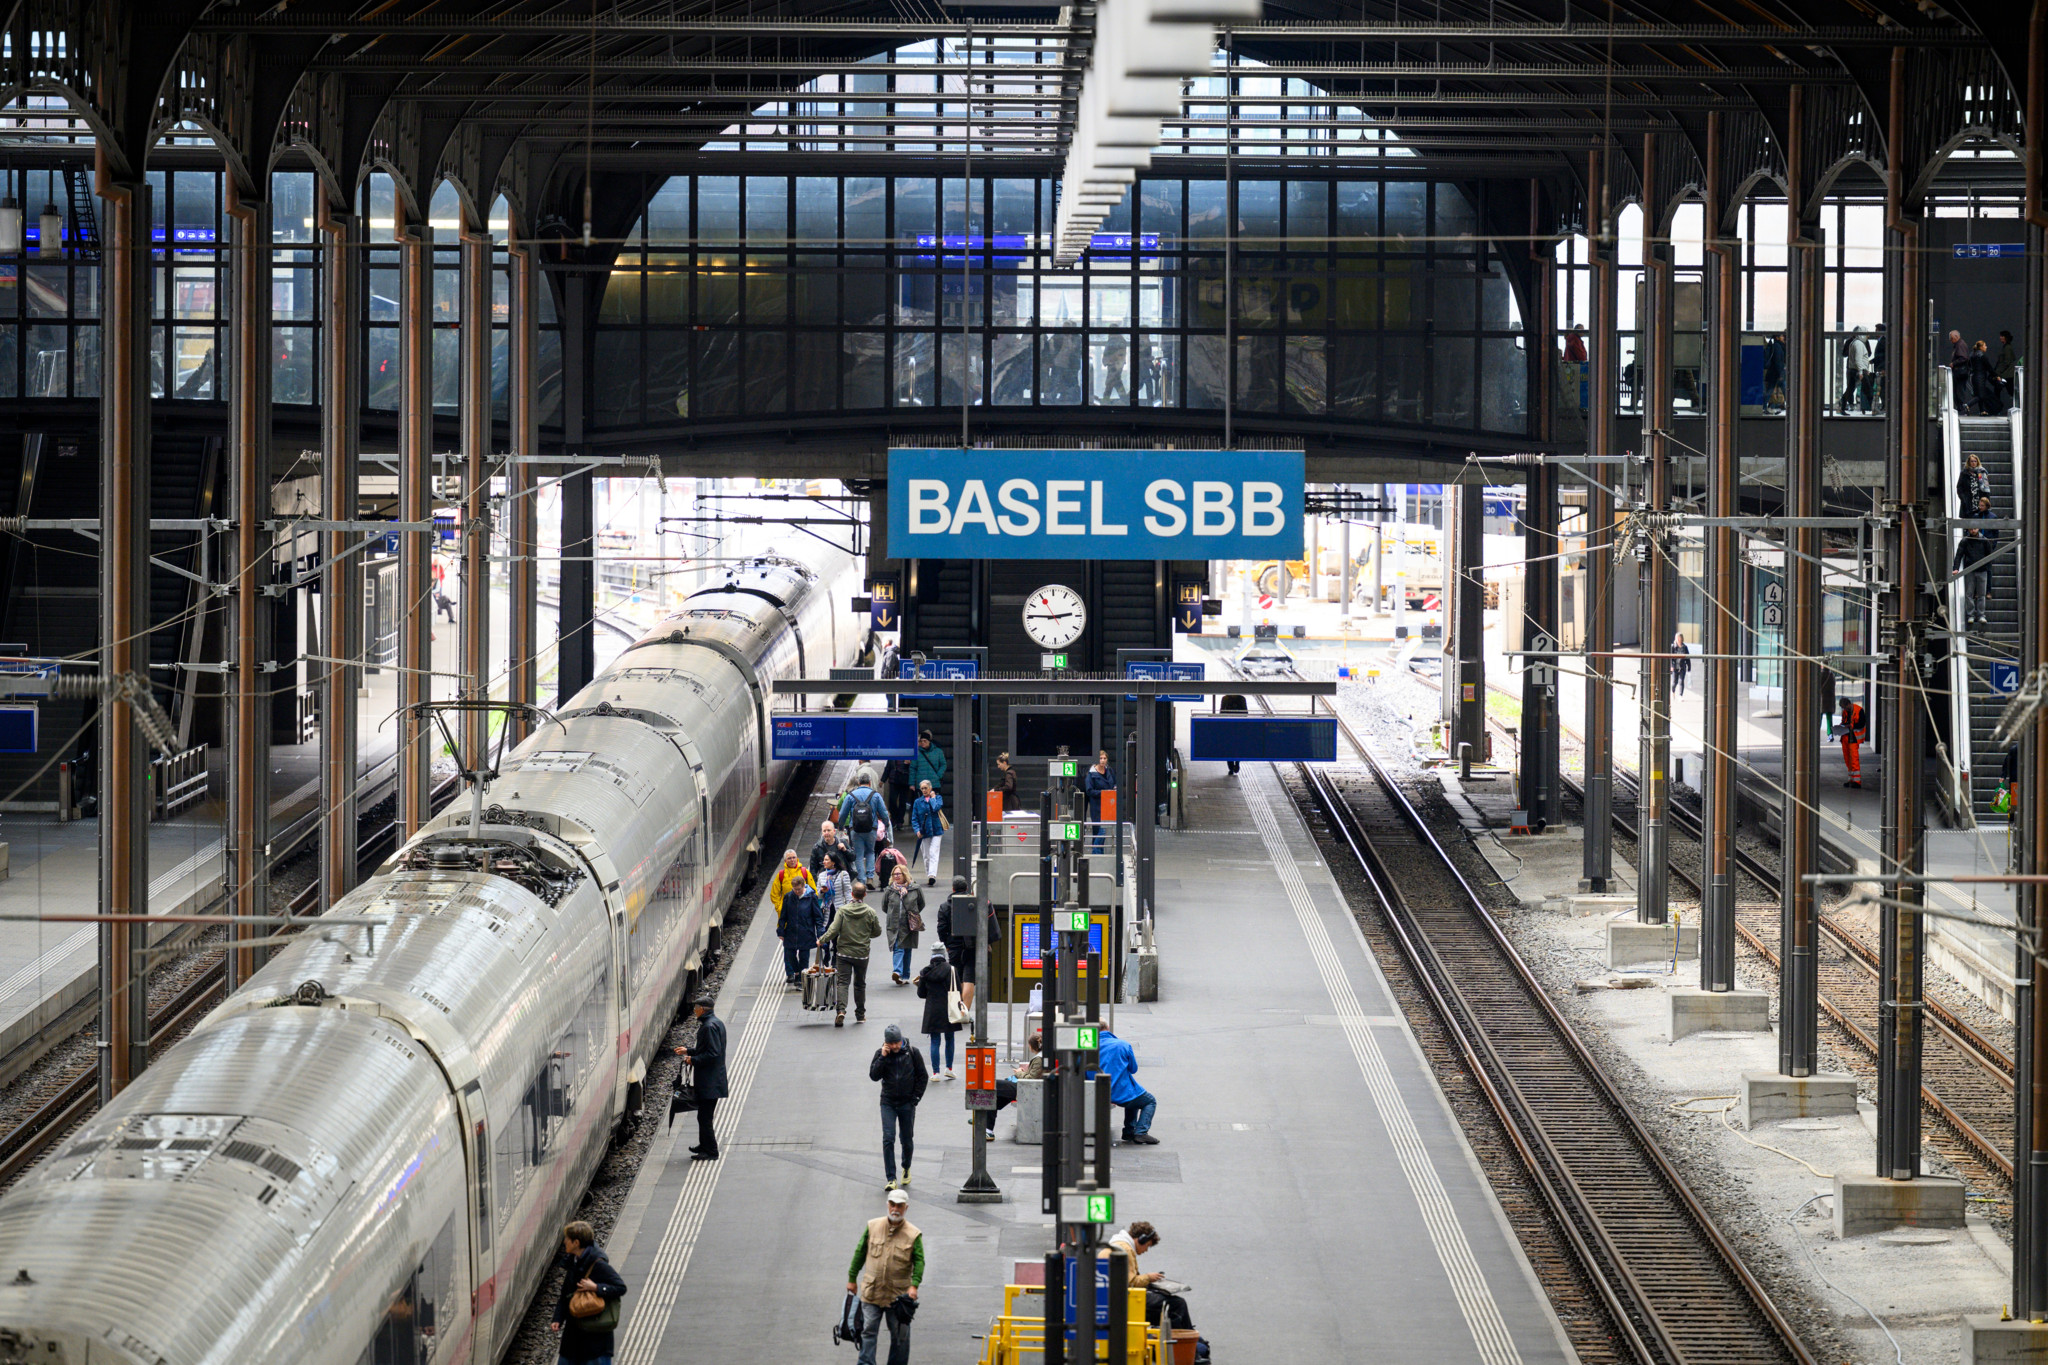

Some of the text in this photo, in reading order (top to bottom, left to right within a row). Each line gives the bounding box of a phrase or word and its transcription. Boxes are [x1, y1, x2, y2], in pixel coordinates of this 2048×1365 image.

[908, 478, 1286, 537] BASEL SBB
[1485, 506, 1496, 514] 30
[391, 539, 399, 551] 7
[1770, 586, 1777, 600] 4
[1769, 608, 1776, 623] 3
[1537, 637, 1547, 651] 2
[1538, 667, 1545, 683] 1
[2003, 671, 2018, 691] 4
